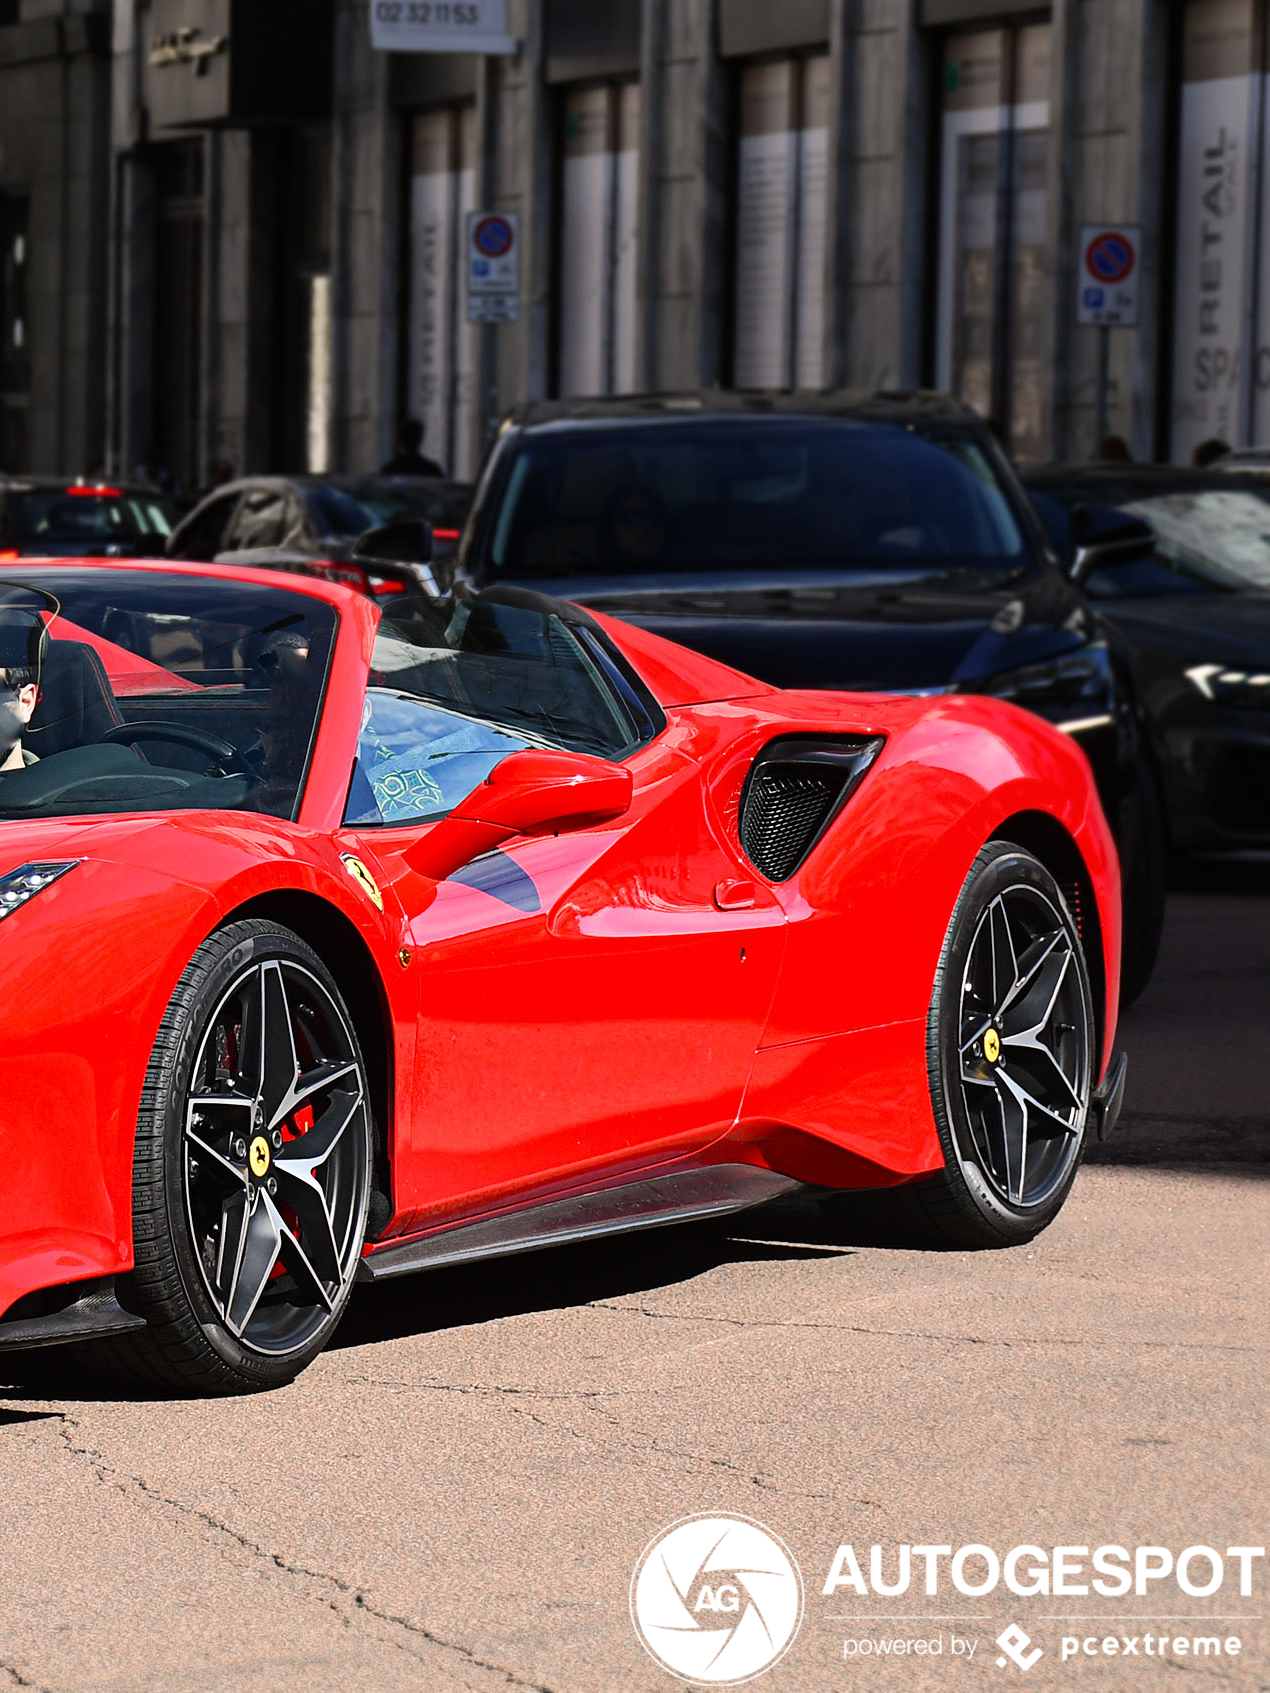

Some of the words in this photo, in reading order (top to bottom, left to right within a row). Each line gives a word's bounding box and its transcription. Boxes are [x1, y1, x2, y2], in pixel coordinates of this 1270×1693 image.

[375, 2, 401, 23] 02
[407, 3, 430, 25] 32
[435, 4, 449, 25] 11
[453, 4, 478, 26] 53
[1200, 126, 1226, 335] RETAIL
